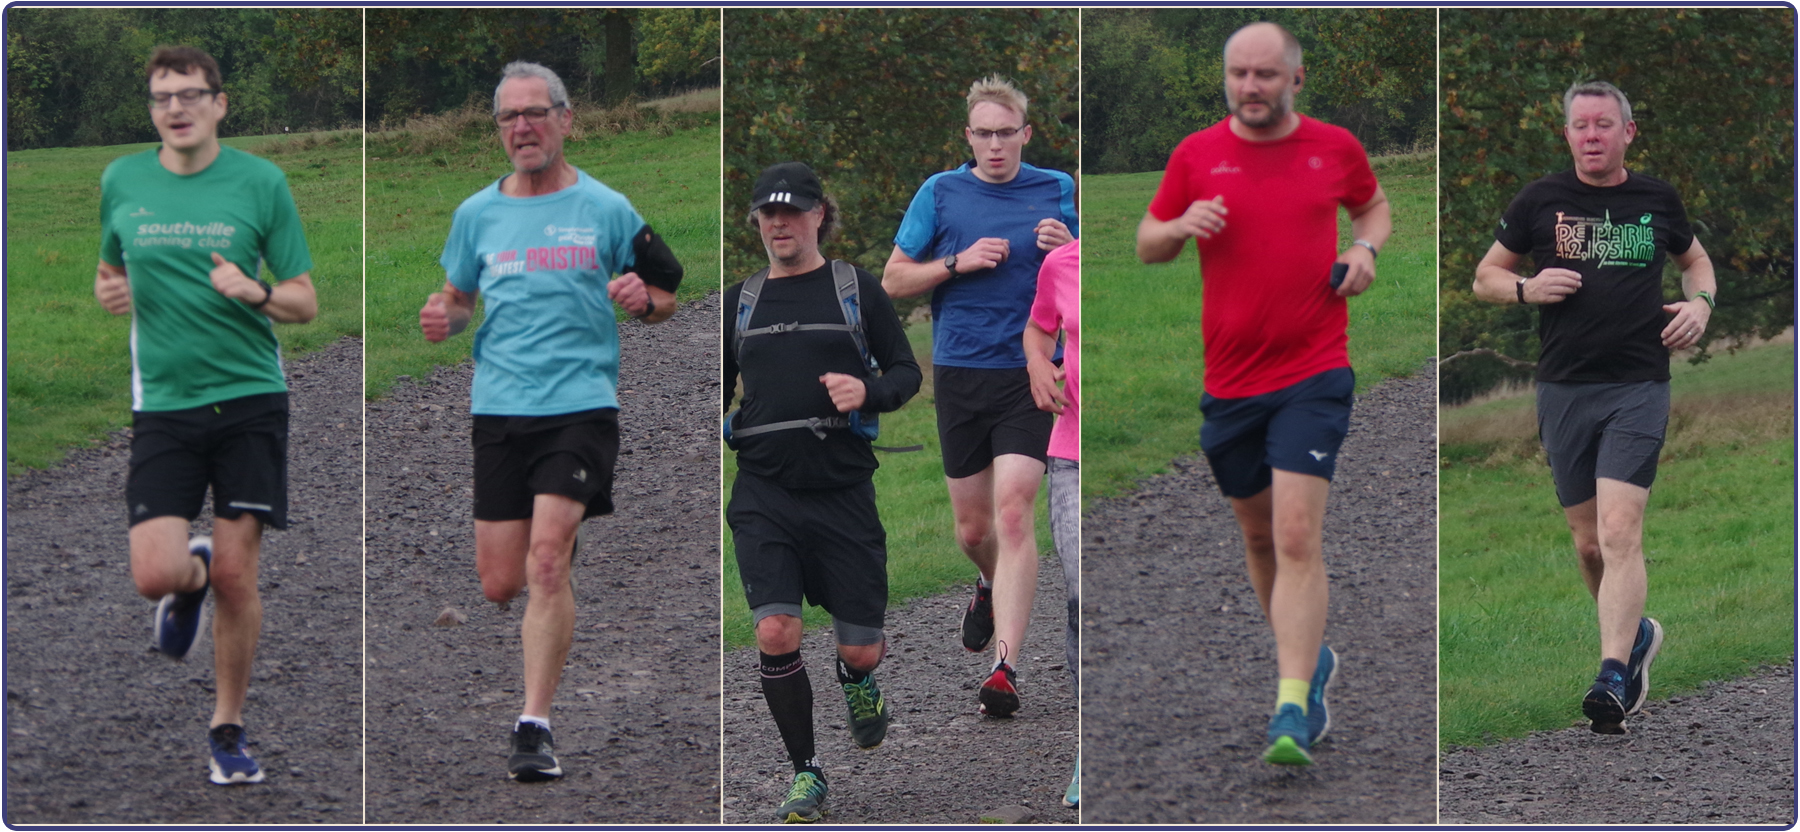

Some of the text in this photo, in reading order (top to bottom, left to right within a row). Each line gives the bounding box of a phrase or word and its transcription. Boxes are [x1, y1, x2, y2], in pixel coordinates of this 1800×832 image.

[137, 221, 235, 237] southville
[1592, 223, 1654, 242] PARIS
[133, 236, 231, 249] running club
[526, 245, 599, 272] BRISTOL
